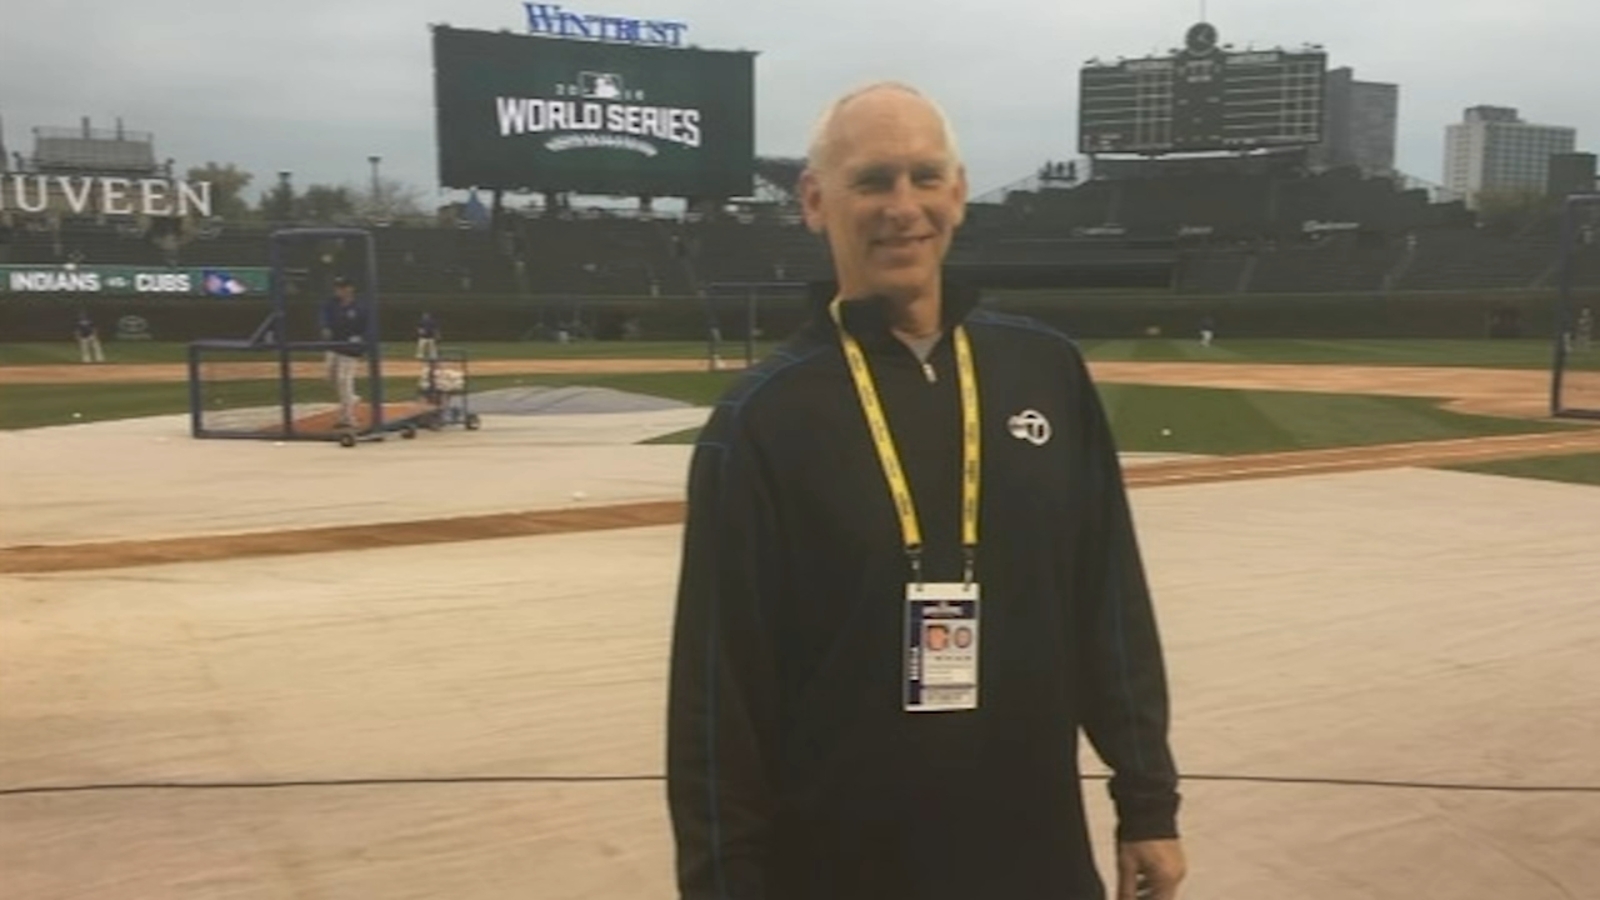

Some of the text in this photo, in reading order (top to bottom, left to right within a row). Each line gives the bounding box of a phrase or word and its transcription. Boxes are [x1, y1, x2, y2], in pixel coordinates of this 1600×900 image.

[523, 3, 687, 46] WINTRUST
[497, 97, 603, 136] WORLD
[606, 105, 702, 147] SERIES
[0, 173, 212, 217] UVEEN
[9, 271, 101, 292] INDIANS
[134, 273, 191, 292] CUBS
